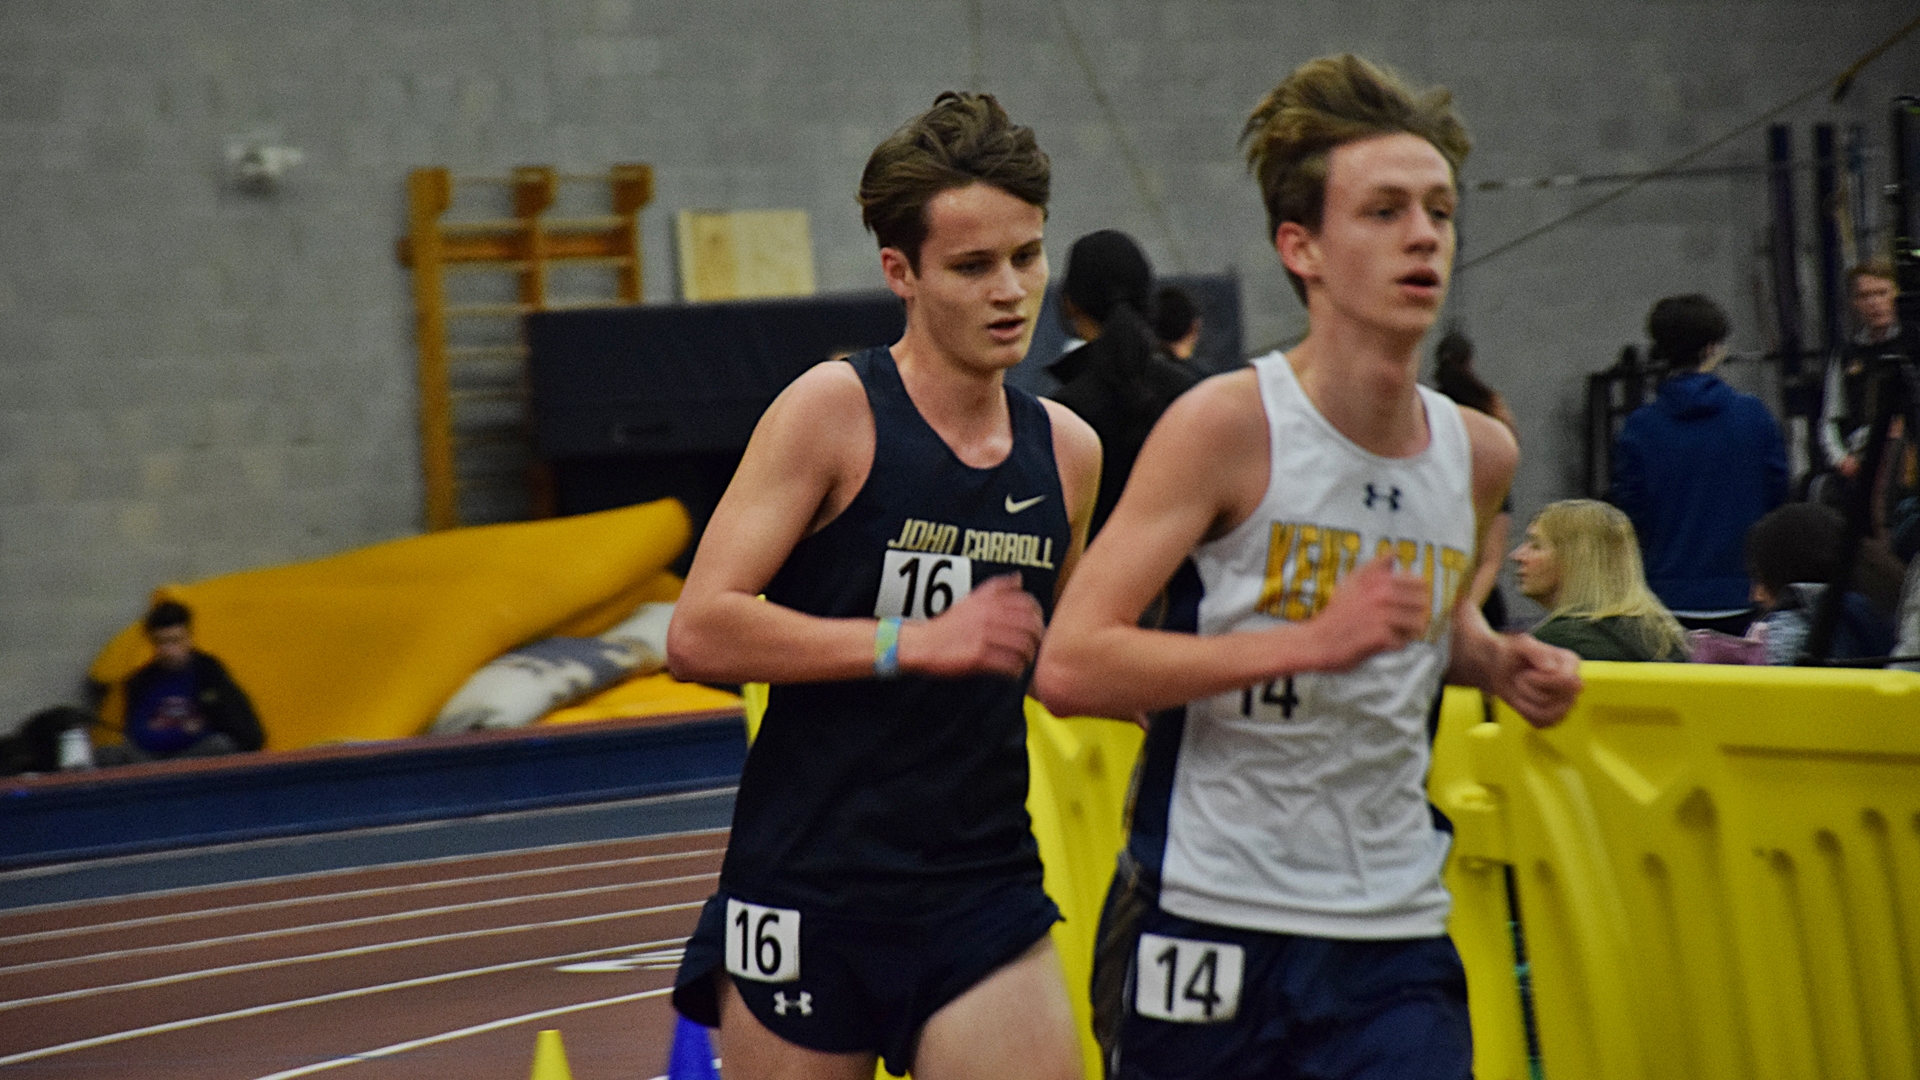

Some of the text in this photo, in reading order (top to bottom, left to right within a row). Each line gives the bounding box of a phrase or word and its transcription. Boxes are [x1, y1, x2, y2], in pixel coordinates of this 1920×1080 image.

[887, 518, 1054, 569] JOHN CARROLL
[898, 556, 953, 618] 16
[735, 908, 782, 976] 16
[1156, 943, 1222, 1017] 14
